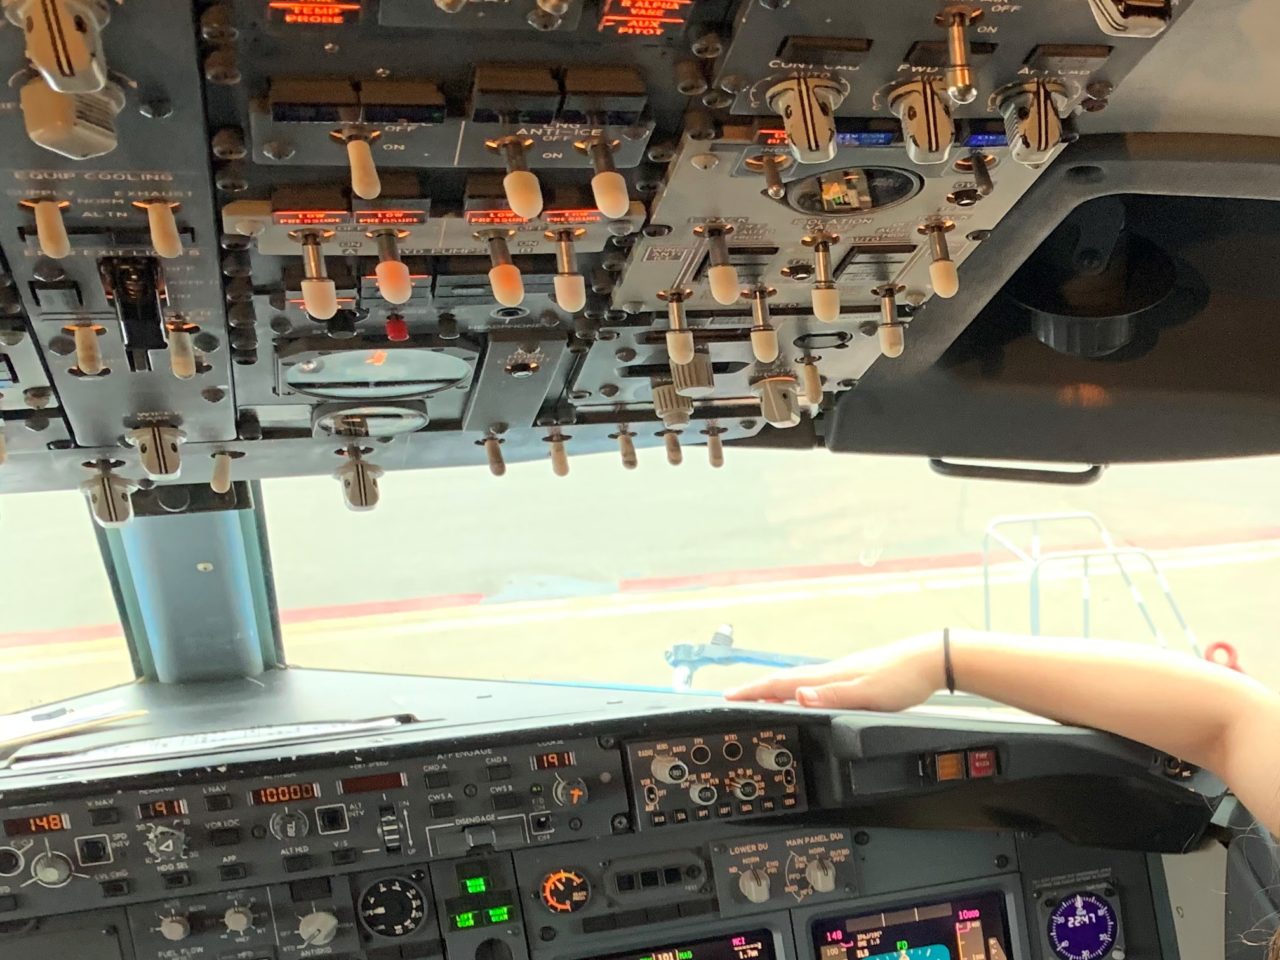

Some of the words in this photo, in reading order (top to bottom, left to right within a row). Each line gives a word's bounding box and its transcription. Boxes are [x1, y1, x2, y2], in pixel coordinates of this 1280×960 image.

[637, 1, 680, 10] ALPHA
[991, 5, 1022, 13] OFF
[290, 7, 341, 16] TEMP
[630, 8, 666, 17] VANE
[285, 14, 344, 24] PROBE
[627, 20, 659, 29] AUX
[618, 27, 664, 36] PITOT
[516, 128, 604, 137] ANTI-ICE
[383, 143, 406, 151] ON
[542, 152, 563, 160] ON
[14, 171, 76, 182] EQUIP
[83, 171, 174, 182] COOLING
[486, 757, 502, 765] CMD
[542, 754, 571, 767] 191
[423, 764, 439, 772] CMD
[260, 783, 313, 803] 10000
[428, 793, 444, 801] CWS
[29, 814, 62, 831] 148
[455, 814, 496, 826] DISENGAGE
[785, 838, 803, 847] MAIN
[804, 834, 829, 844] PANEL
[729, 844, 757, 856] LOWER
[758, 843, 769, 851] DU
[456, 912, 473, 921] LEFT
[826, 930, 843, 942] 148
[896, 940, 908, 950] FD
